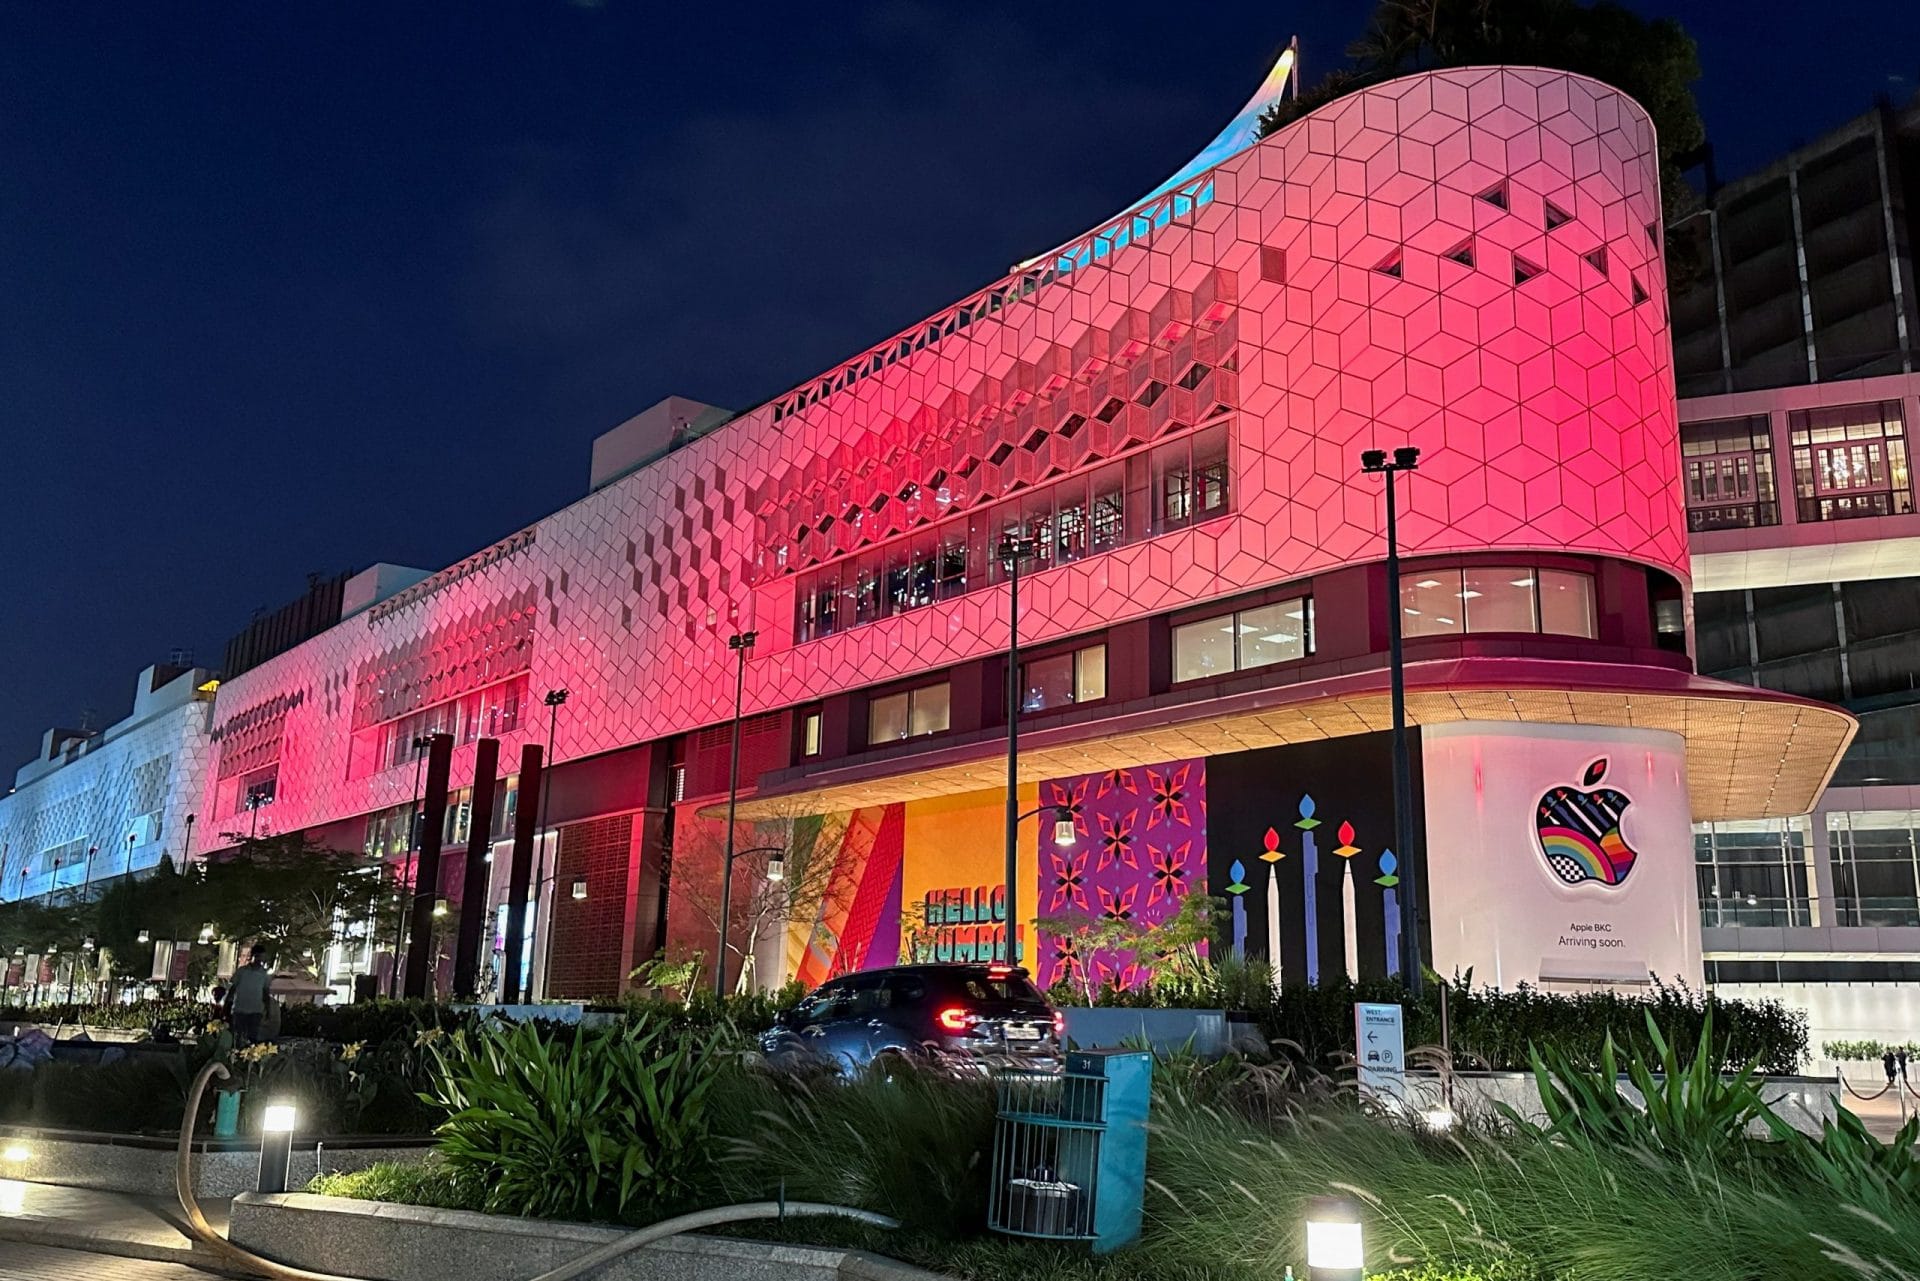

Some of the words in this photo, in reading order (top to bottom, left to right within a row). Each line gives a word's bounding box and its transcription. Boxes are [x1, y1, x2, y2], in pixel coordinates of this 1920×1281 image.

[925, 885, 1006, 925] HELLO
[1570, 923, 1593, 933] Apple
[1594, 923, 1612, 933] BKC
[1558, 935, 1597, 949] Arriving
[1599, 939, 1626, 948] soon.
[1368, 1066, 1397, 1074] PARKING
